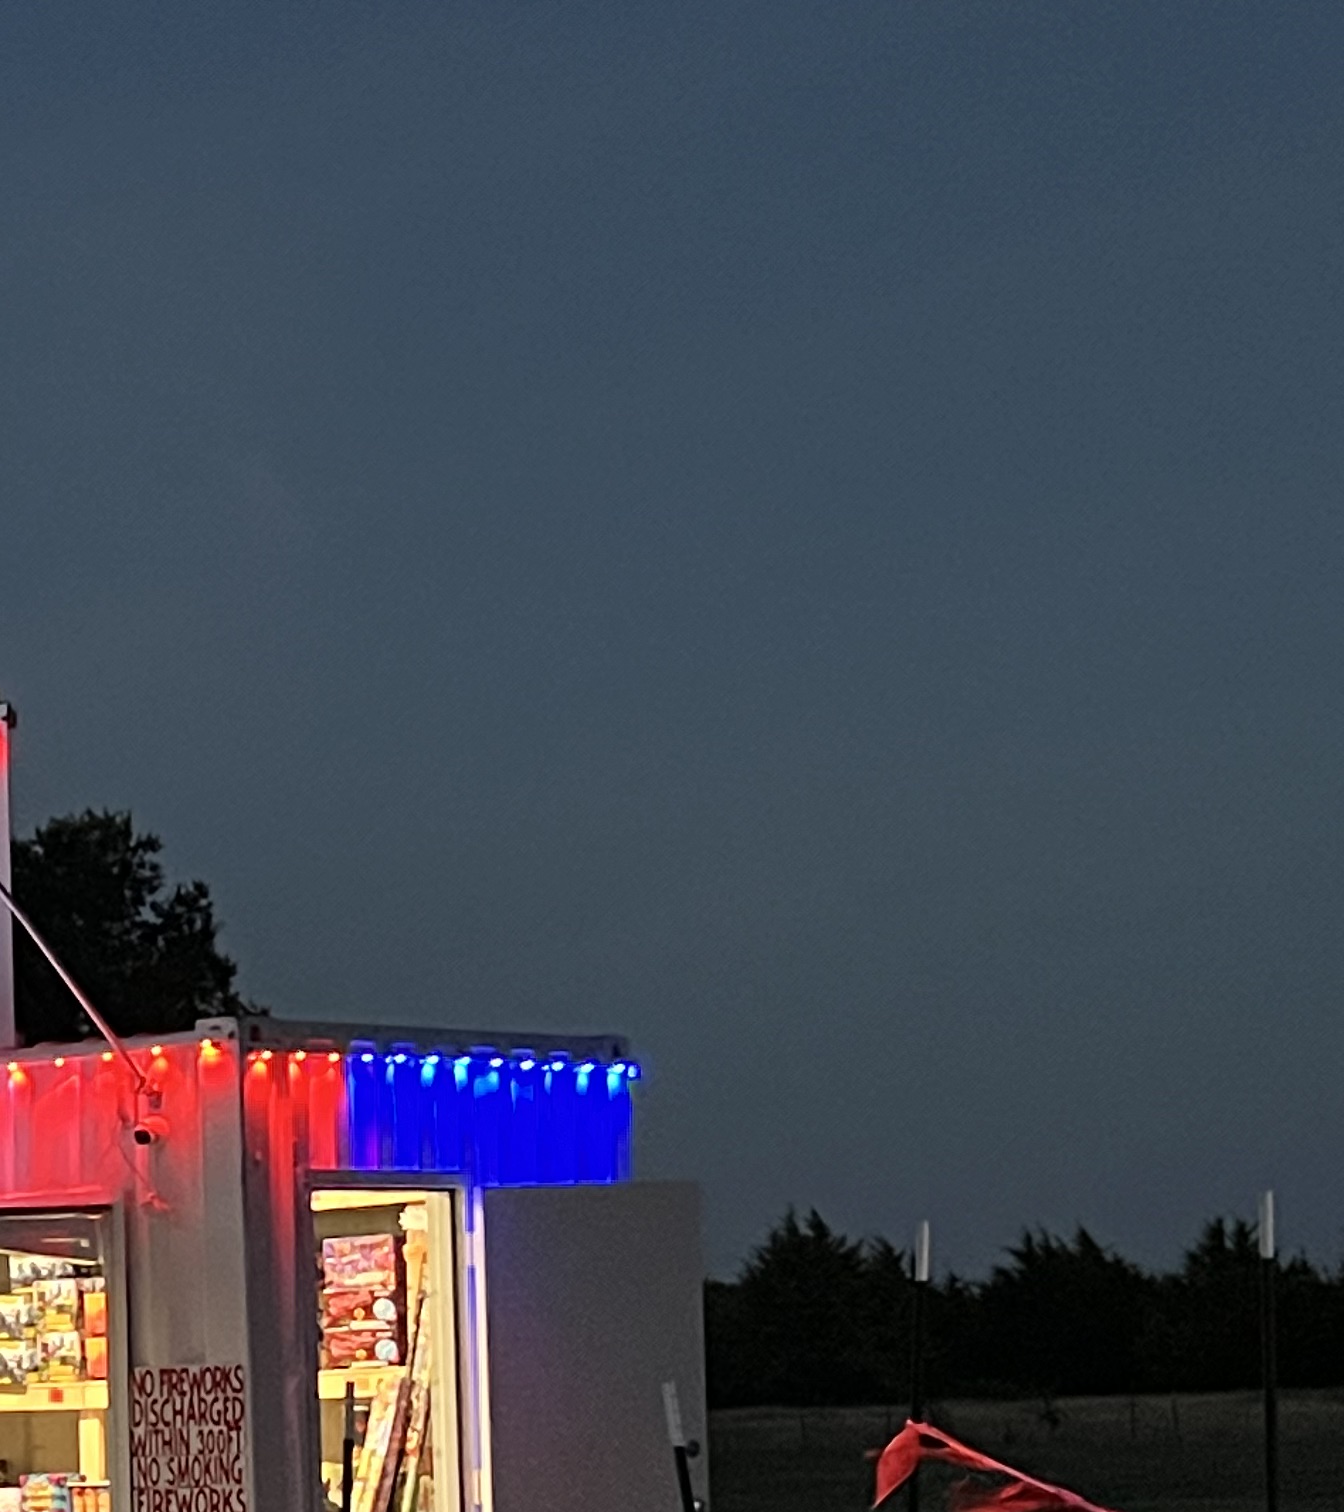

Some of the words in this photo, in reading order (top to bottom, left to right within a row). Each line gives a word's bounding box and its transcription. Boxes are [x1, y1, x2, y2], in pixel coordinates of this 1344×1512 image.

[132, 1369, 155, 1398] NO
[132, 1396, 245, 1429] DISCHARGED
[129, 1427, 191, 1457] WITHIN
[137, 1457, 161, 1487] NO
[166, 1454, 243, 1488] SMOKING
